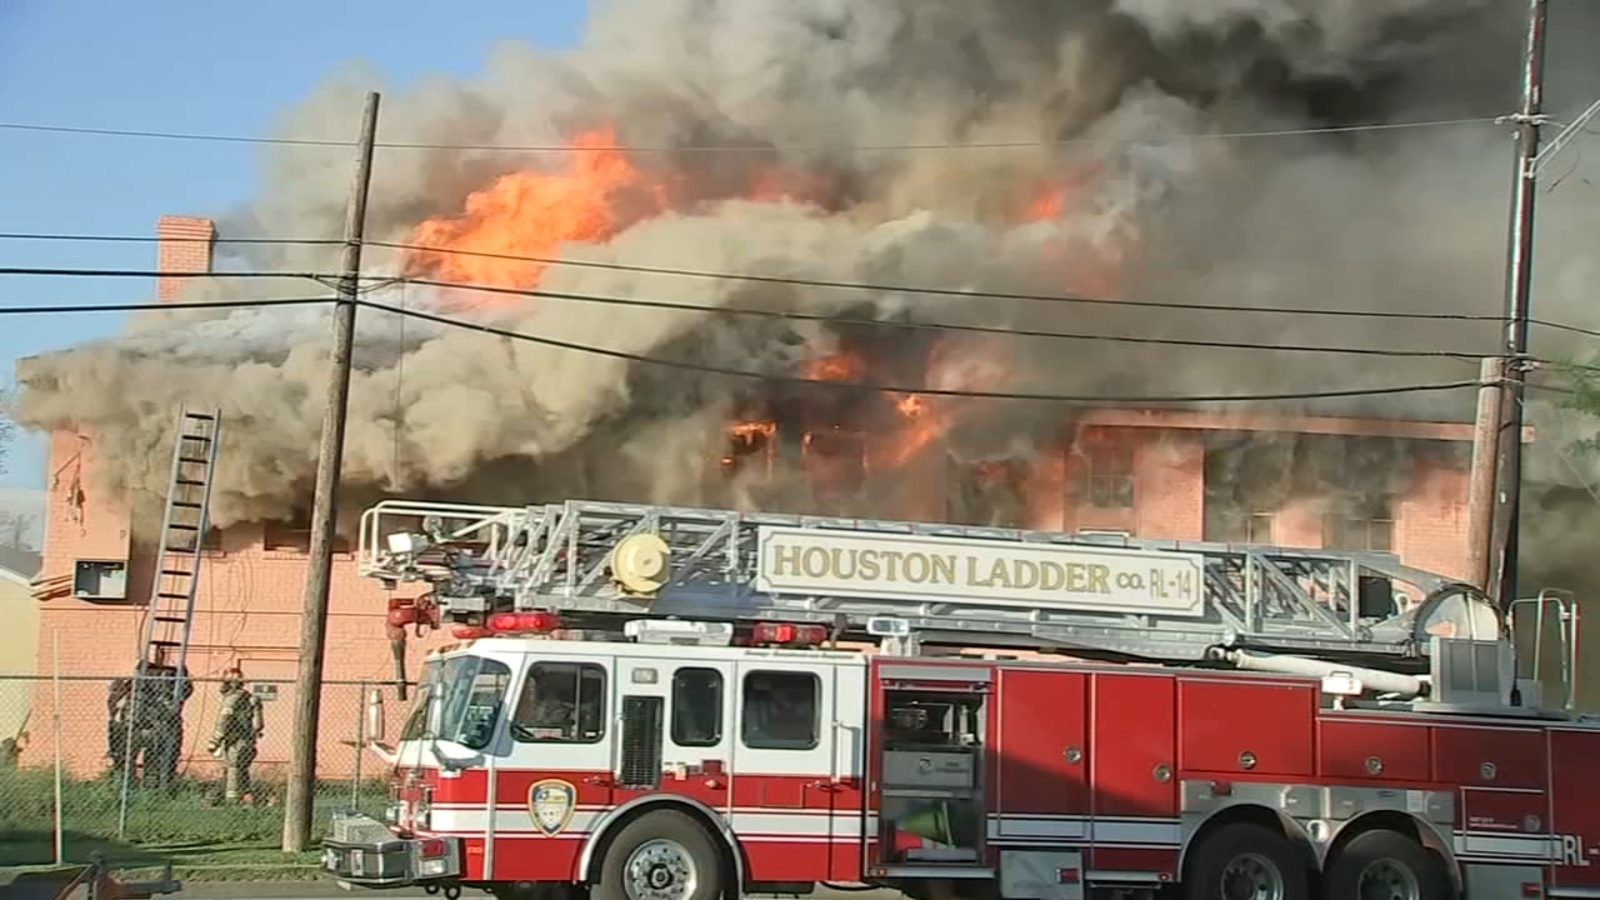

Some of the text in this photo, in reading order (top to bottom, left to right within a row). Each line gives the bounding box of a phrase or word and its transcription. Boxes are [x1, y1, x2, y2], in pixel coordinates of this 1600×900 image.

[773, 544, 957, 585] HOUSTON
[966, 556, 1111, 594] LADDER
[1149, 568, 1192, 601] RL-14
